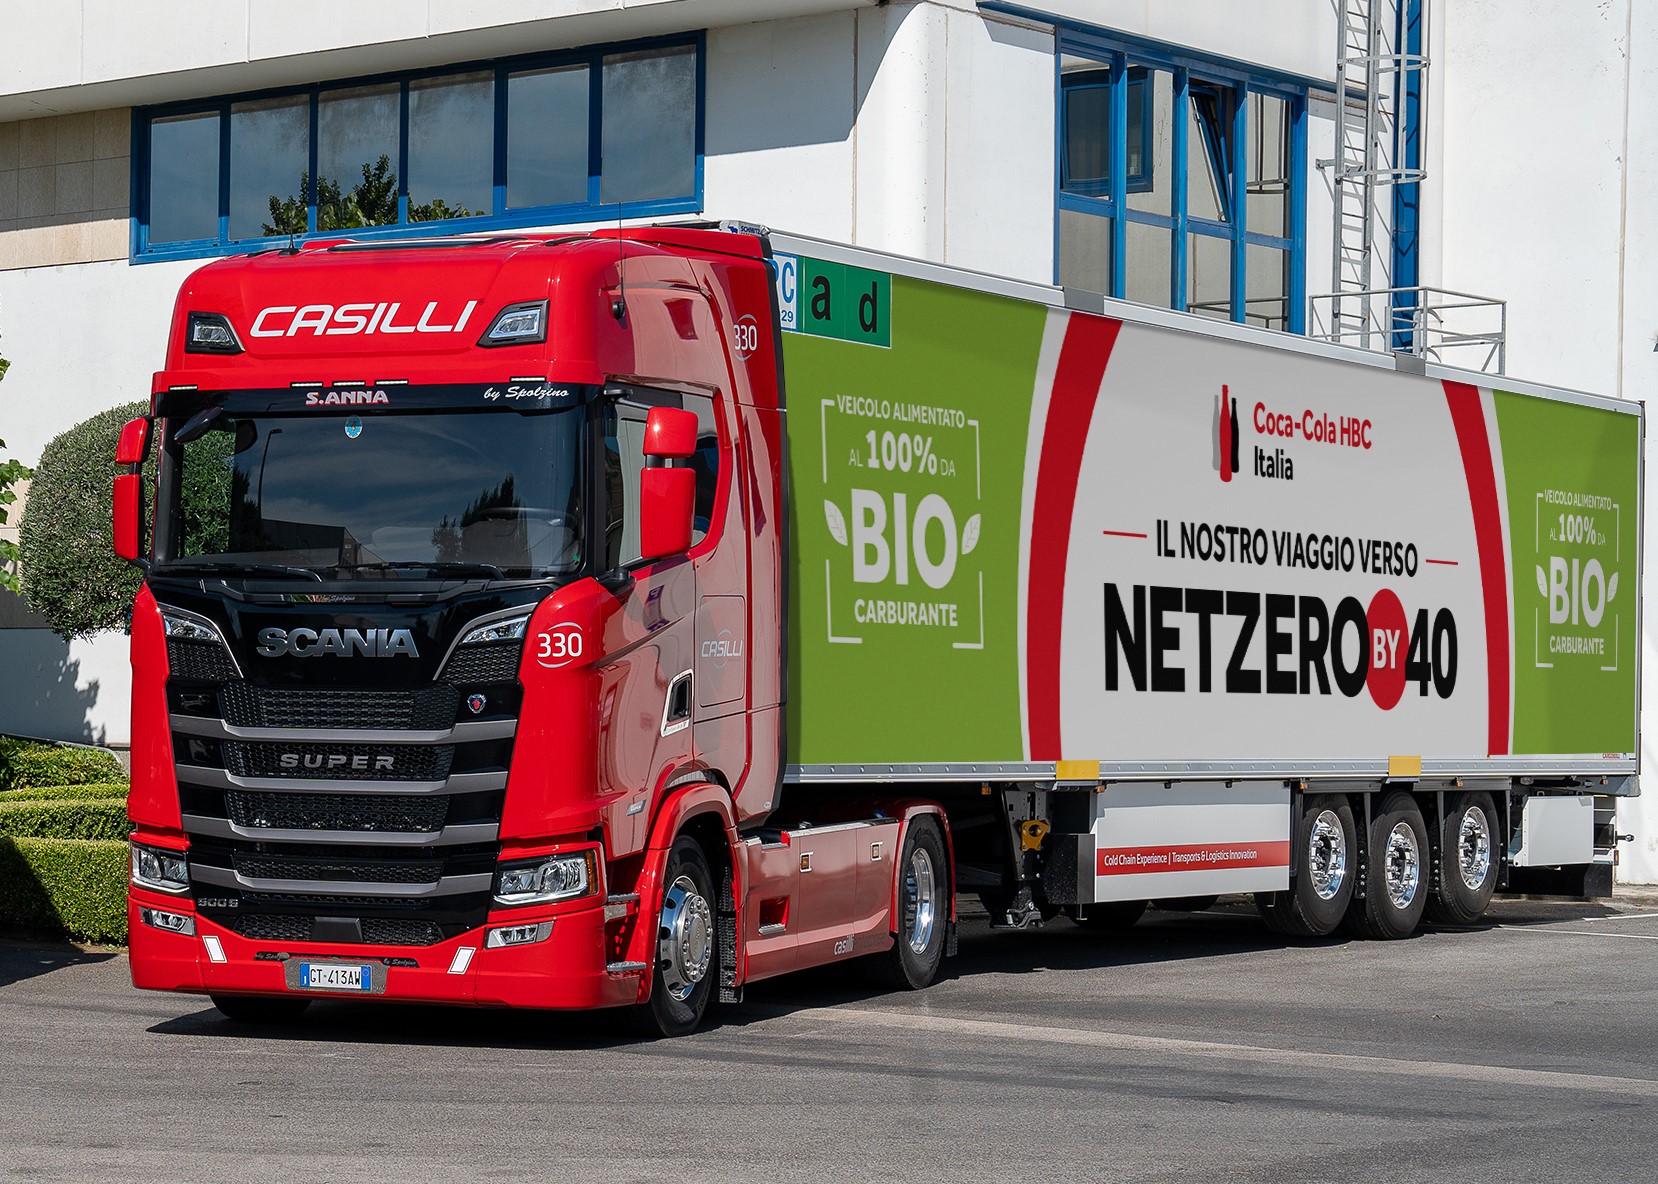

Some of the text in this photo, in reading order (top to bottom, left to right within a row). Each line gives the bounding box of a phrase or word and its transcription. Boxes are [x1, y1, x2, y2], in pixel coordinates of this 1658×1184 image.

[250, 300, 478, 338] CASILLI
[781, 310, 794, 323] 29
[811, 275, 878, 333] a d
[733, 324, 758, 351] 330
[305, 390, 389, 407] S.ANNA
[483, 386, 569, 401] by Spolzino
[836, 394, 965, 429] VEICOLO ALIMENTATO
[1253, 401, 1372, 449] Coca-Cola HBC
[849, 430, 956, 477] AL 100% DA
[1254, 445, 1293, 480] Italia
[1544, 489, 1612, 511] VEICOLO ALIMENTATO
[851, 488, 958, 589] BIO
[1549, 513, 1606, 546] AL 100% DA
[1156, 519, 1418, 578] IL NOSTRO VIAGGIO VERSO
[1549, 556, 1606, 628] BIO
[854, 599, 958, 628] CARBURANTE
[256, 627, 420, 658] SCANIA
[537, 632, 583, 657] 330
[701, 640, 744, 657] CASILLI
[1103, 582, 1458, 699] NETZERO BY 40
[1549, 635, 1604, 655] CARBURANTE
[280, 753, 394, 770] SUPER
[1103, 854, 1119, 866] Cold
[1119, 853, 1137, 865] Chain
[1137, 852, 1167, 866] Experience
[1171, 851, 1200, 864] Transports
[1206, 850, 1229, 863] Logistics
[1230, 849, 1258, 860] Innovation
